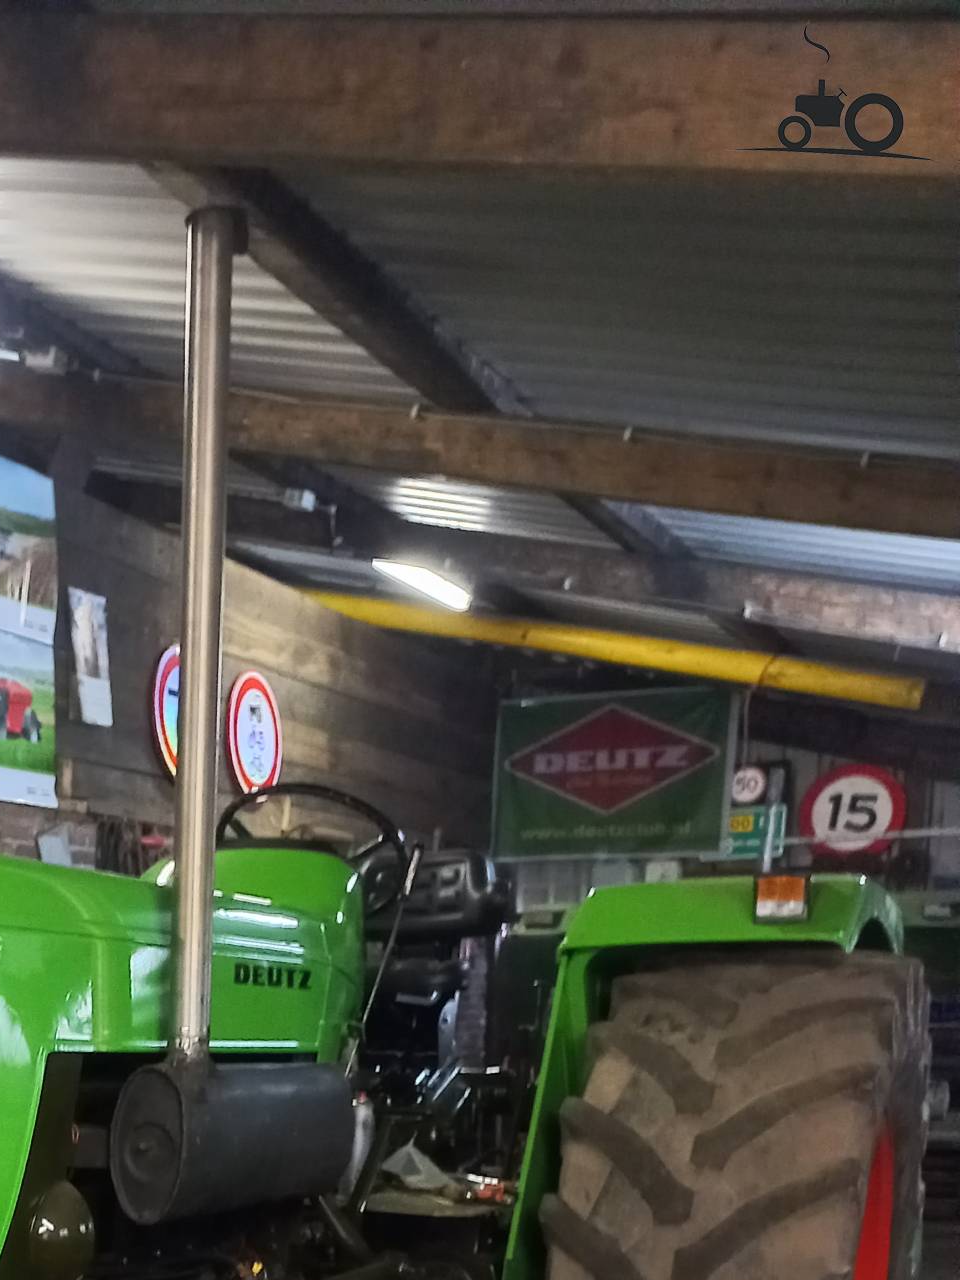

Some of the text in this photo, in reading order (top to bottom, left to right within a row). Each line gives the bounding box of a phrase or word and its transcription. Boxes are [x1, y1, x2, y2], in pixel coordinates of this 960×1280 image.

[533, 744, 691, 774] DEUTZ
[828, 793, 878, 833] 15
[234, 963, 311, 990] DEUTZ
